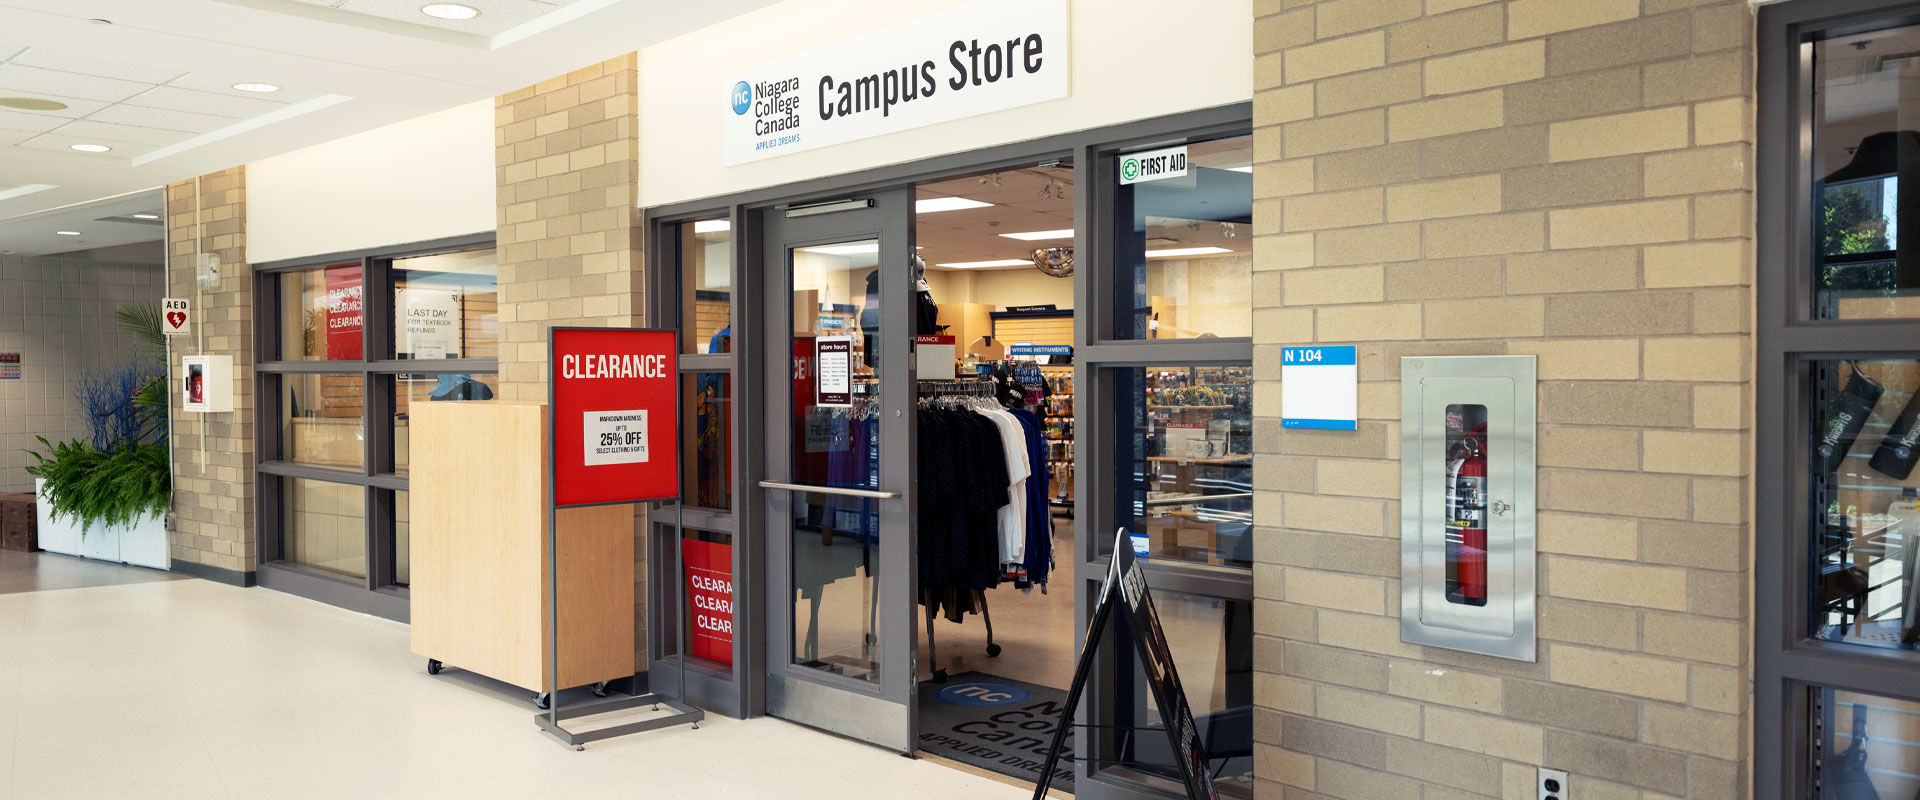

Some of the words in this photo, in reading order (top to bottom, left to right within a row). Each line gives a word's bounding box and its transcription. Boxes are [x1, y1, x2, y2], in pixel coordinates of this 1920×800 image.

[818, 60, 936, 121] Campus
[948, 32, 1043, 91] Store
[734, 90, 748, 106] nc
[755, 77, 799, 100] Niagara
[755, 96, 800, 118] College
[755, 112, 800, 136] Canada
[756, 138, 777, 151] APPLIED
[1140, 156, 1167, 176] FIRST
[1169, 153, 1186, 172] AID
[166, 300, 187, 310] AED
[407, 308, 431, 317] LAST
[432, 309, 448, 318] DAY
[1284, 349, 1294, 362] N
[1298, 349, 1322, 362] 104
[562, 354, 667, 379] CLEARANCE
[600, 432, 623, 446] 25%
[625, 432, 642, 445] OFF
[697, 614, 733, 634] CLEAR
[953, 685, 1013, 702] nc
[918, 733, 1003, 759] APPLIED
[998, 756, 1075, 782] DREM
